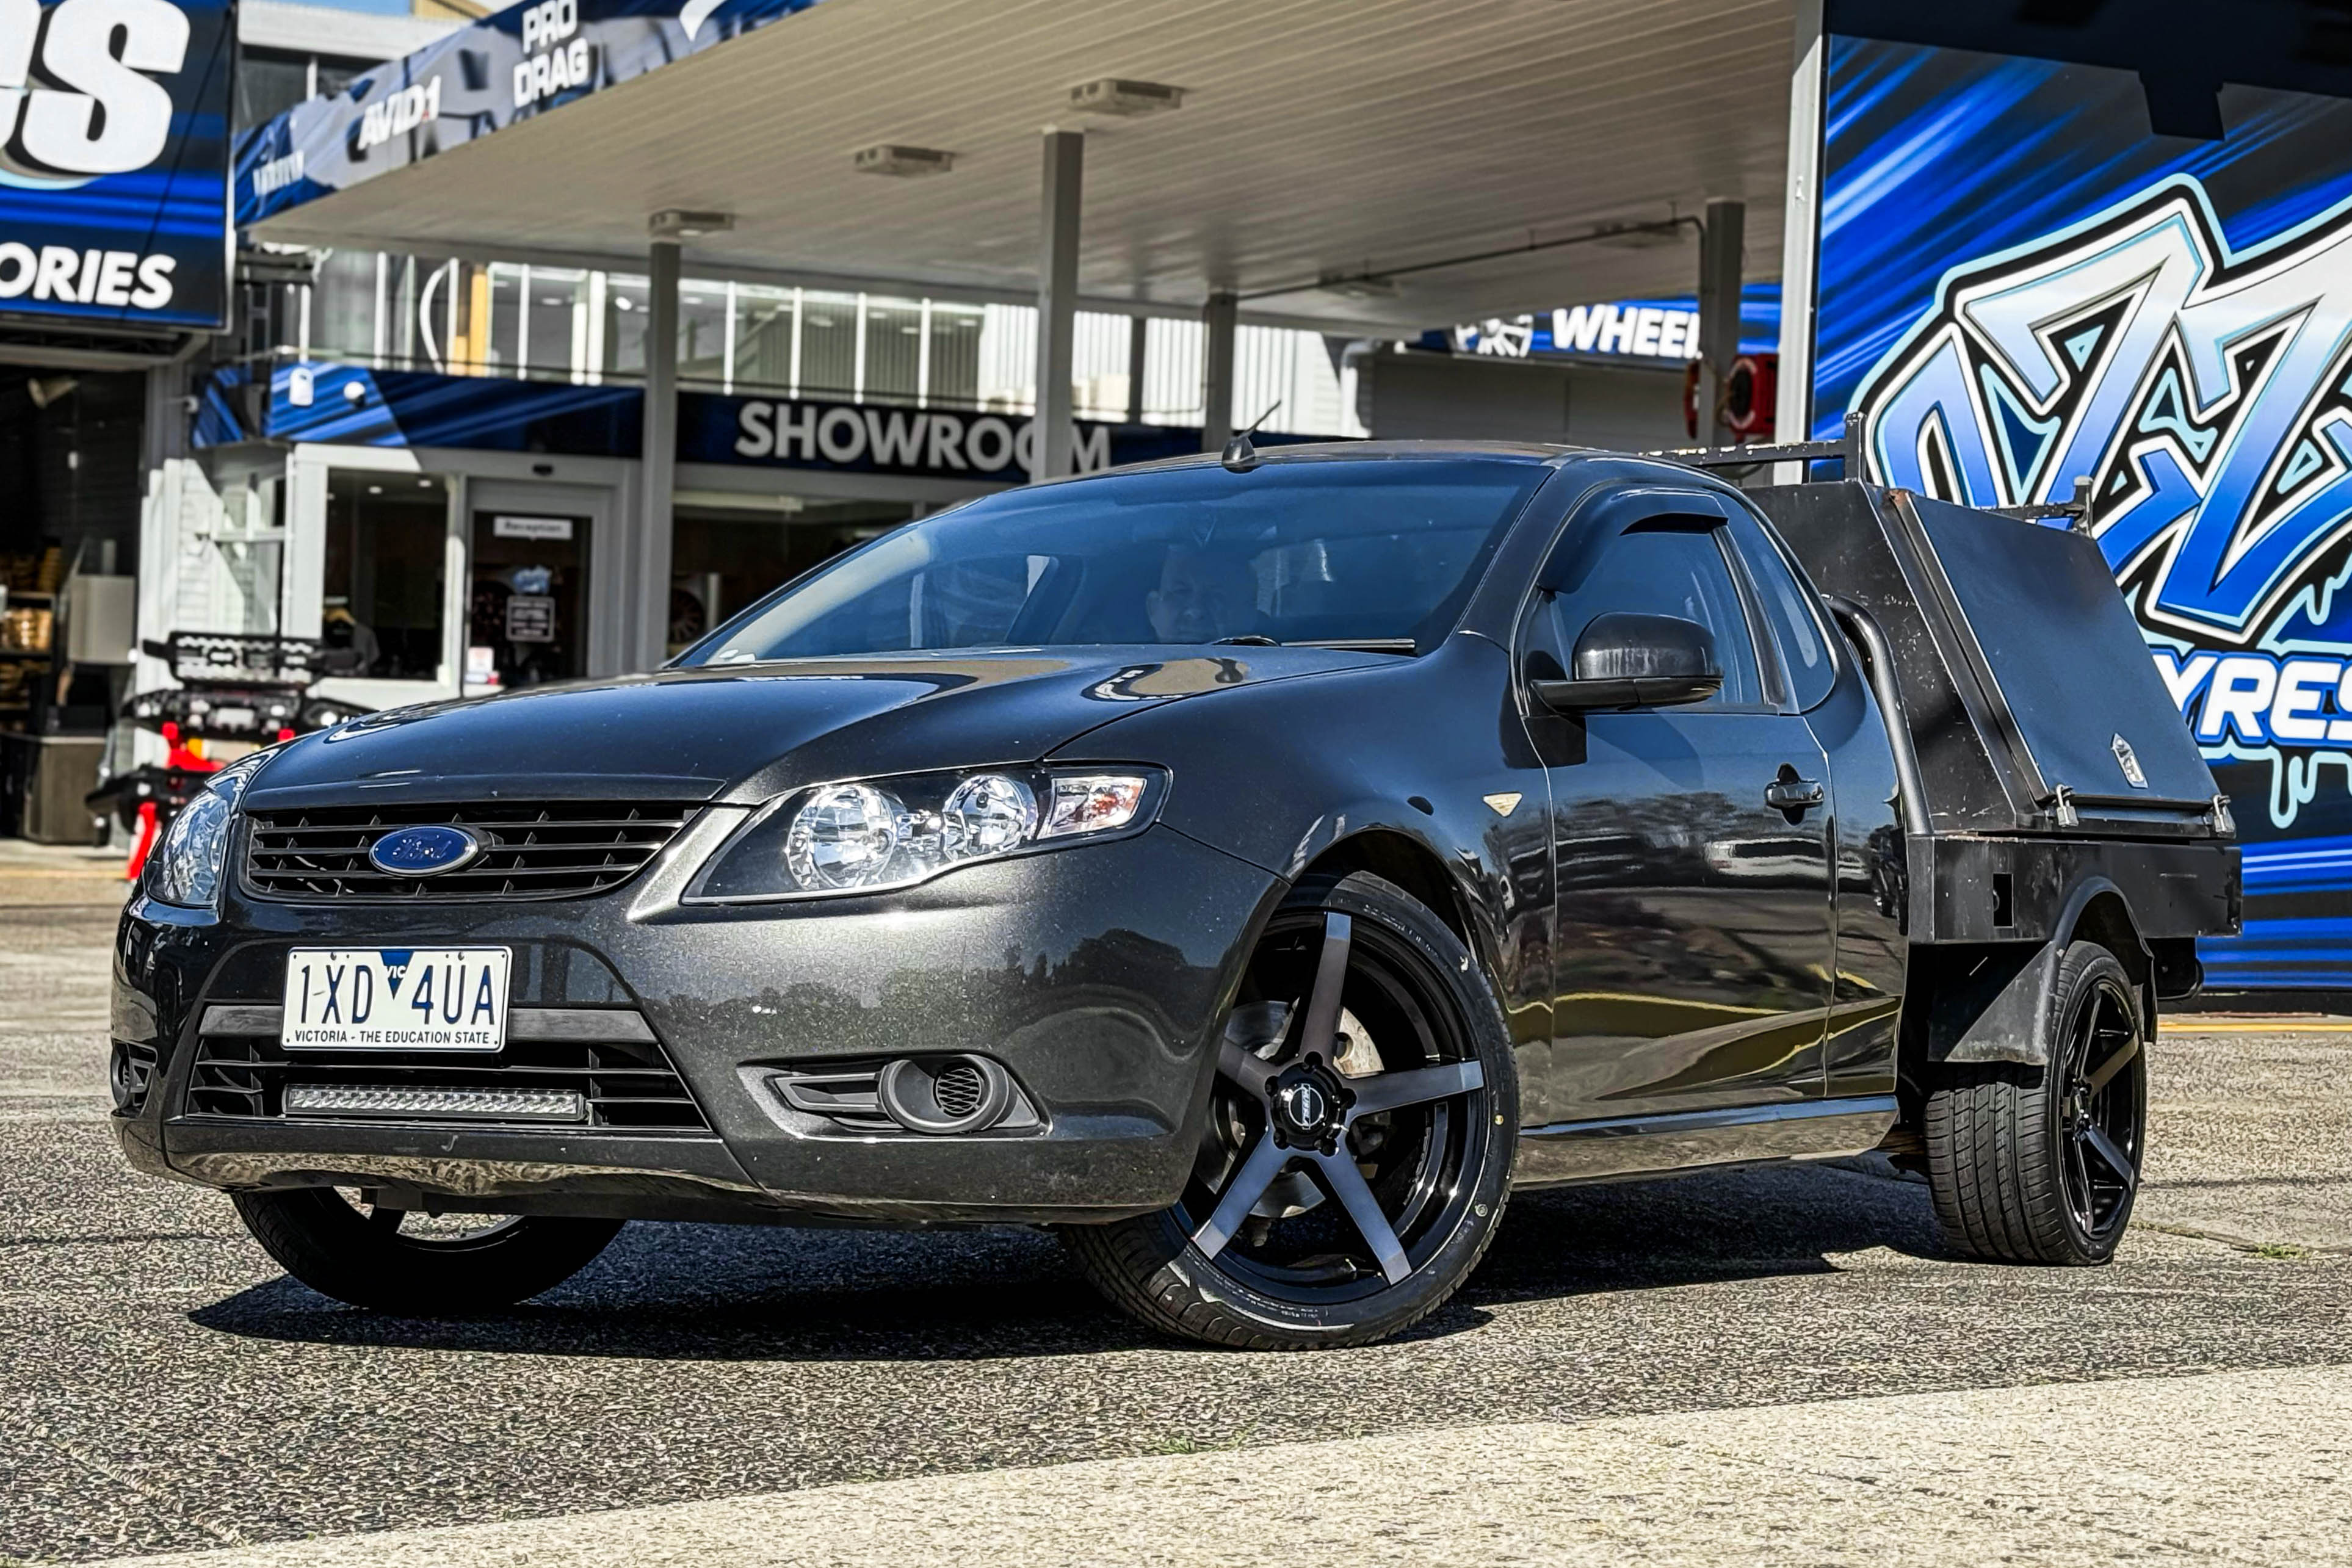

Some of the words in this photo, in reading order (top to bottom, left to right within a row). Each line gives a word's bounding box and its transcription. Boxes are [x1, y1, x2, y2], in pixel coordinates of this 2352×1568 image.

[523, 0, 577, 54] PRO
[514, 37, 588, 108] DRAG
[393, 834, 452, 861] Ford
[386, 965, 407, 979] VIC
[301, 964, 374, 1024] 1XD
[411, 964, 494, 1025] 4UA
[295, 1030, 347, 1042] VICTORIA
[360, 1030, 381, 1042] THE
[385, 1030, 453, 1044] EDUCATION
[455, 1031, 490, 1044] STATE
